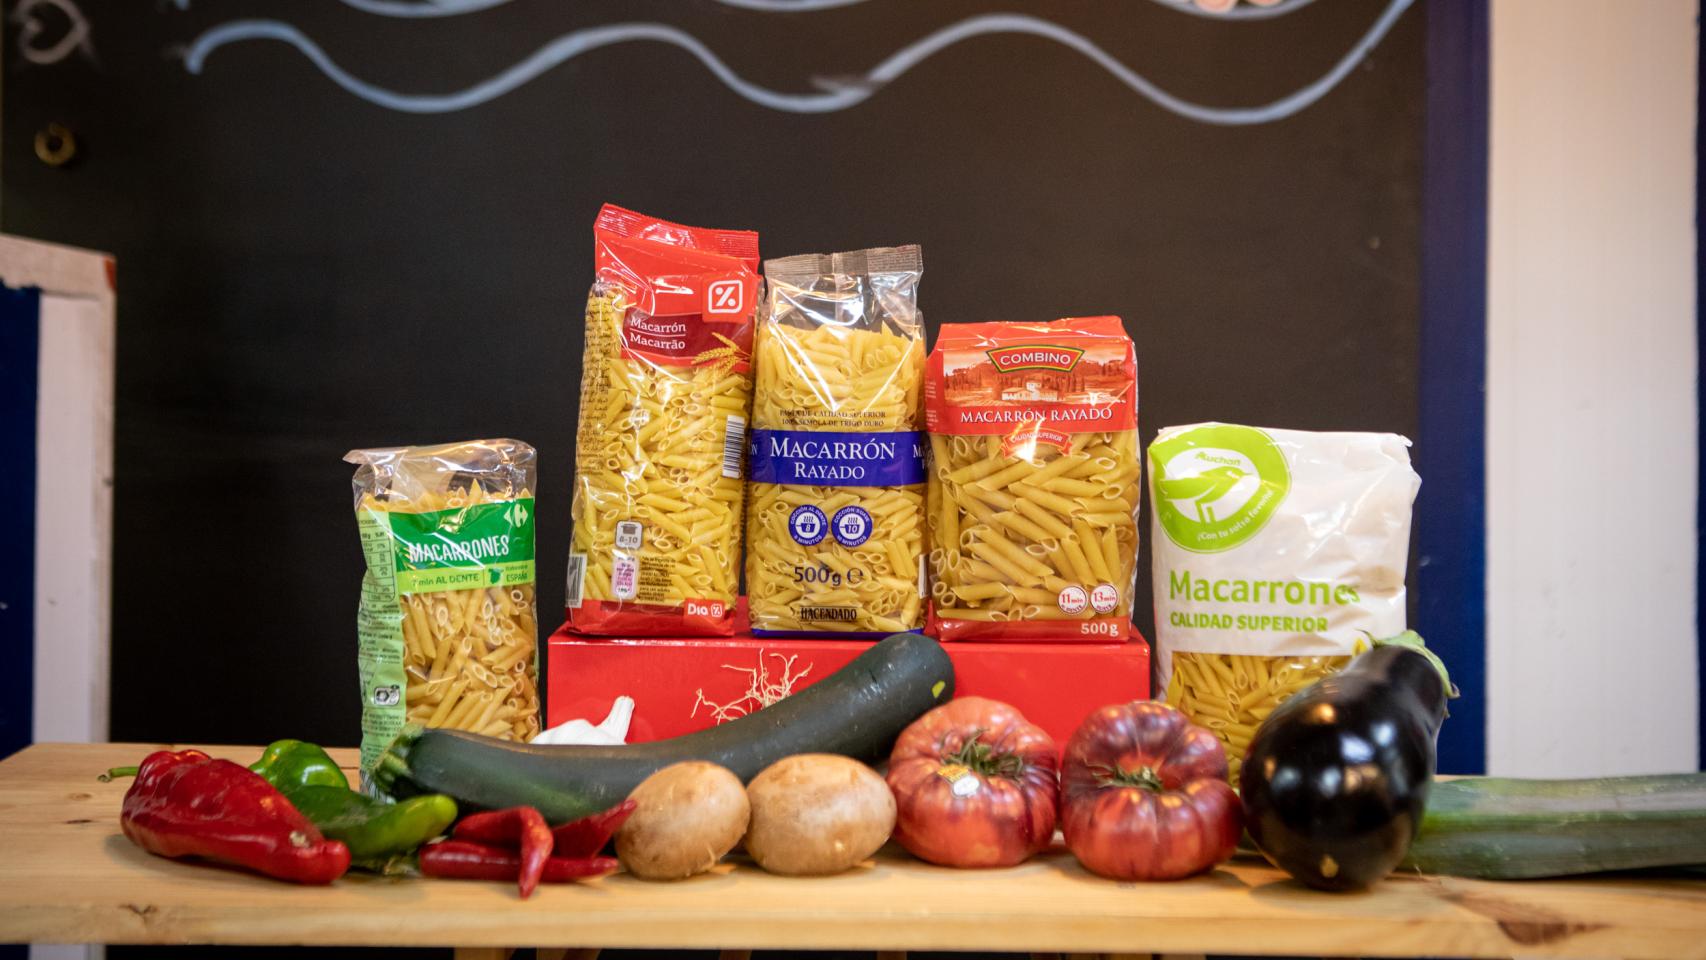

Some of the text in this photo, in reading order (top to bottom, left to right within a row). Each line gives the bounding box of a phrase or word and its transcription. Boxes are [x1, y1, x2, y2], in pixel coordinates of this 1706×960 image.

[630, 317, 687, 333] Macarrón
[629, 332, 687, 350] Macarrão
[1000, 351, 1071, 366] COMBINO
[961, 407, 1113, 424] MACARRÓN RAYADO
[770, 437, 896, 460] MACARRÓN
[1195, 451, 1241, 466] Auchan
[794, 462, 865, 480] RAYADO
[805, 524, 811, 532] 8
[847, 525, 858, 534] 10
[798, 534, 823, 546] MINUTOS
[841, 535, 868, 546] MINUTOS
[409, 534, 510, 563] MACARRONES
[435, 574, 448, 584] AL
[449, 573, 479, 583] DENTE
[1169, 570, 1361, 606] Macarrones
[687, 603, 708, 617] Dia
[800, 607, 858, 620] HACENDADO
[1170, 612, 1329, 633] CALIDAD SUPERIOR
